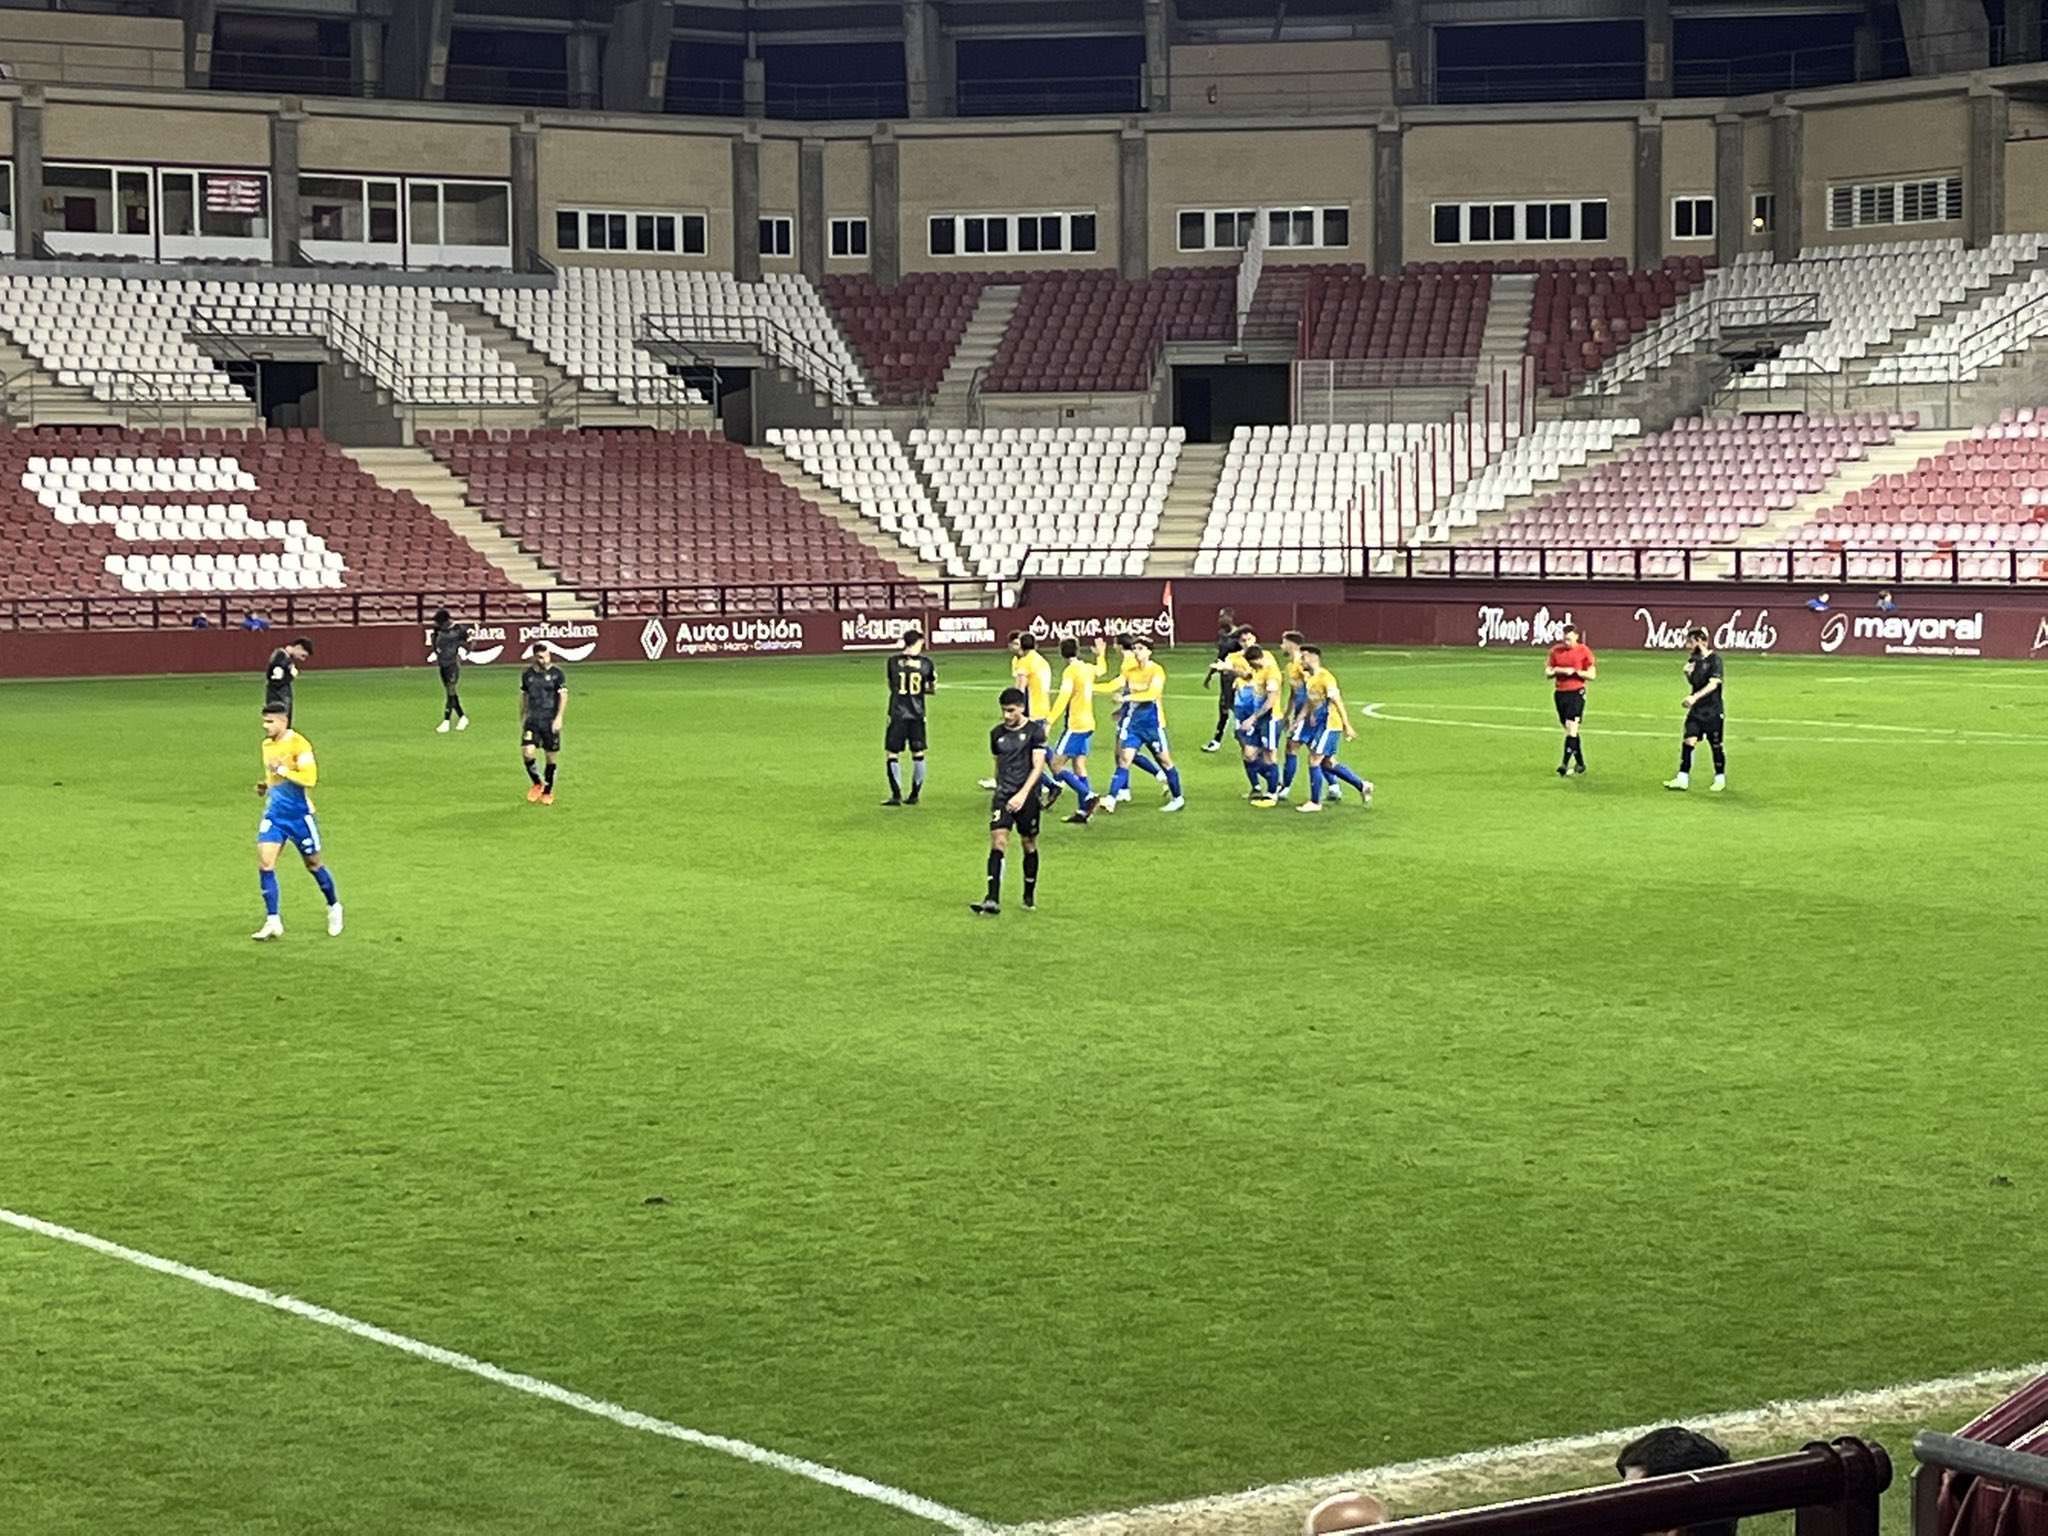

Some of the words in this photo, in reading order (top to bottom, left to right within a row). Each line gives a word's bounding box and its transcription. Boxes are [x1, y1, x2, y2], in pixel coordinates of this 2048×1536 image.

[519, 620, 599, 643] peñaclara
[676, 623, 729, 642] Auto
[732, 619, 803, 640] Urbión
[1103, 617, 1154, 637] HOUSE
[1478, 605, 1530, 647] Monte
[1713, 609, 1777, 649] Chuchi
[1853, 602, 1984, 646] mayoral
